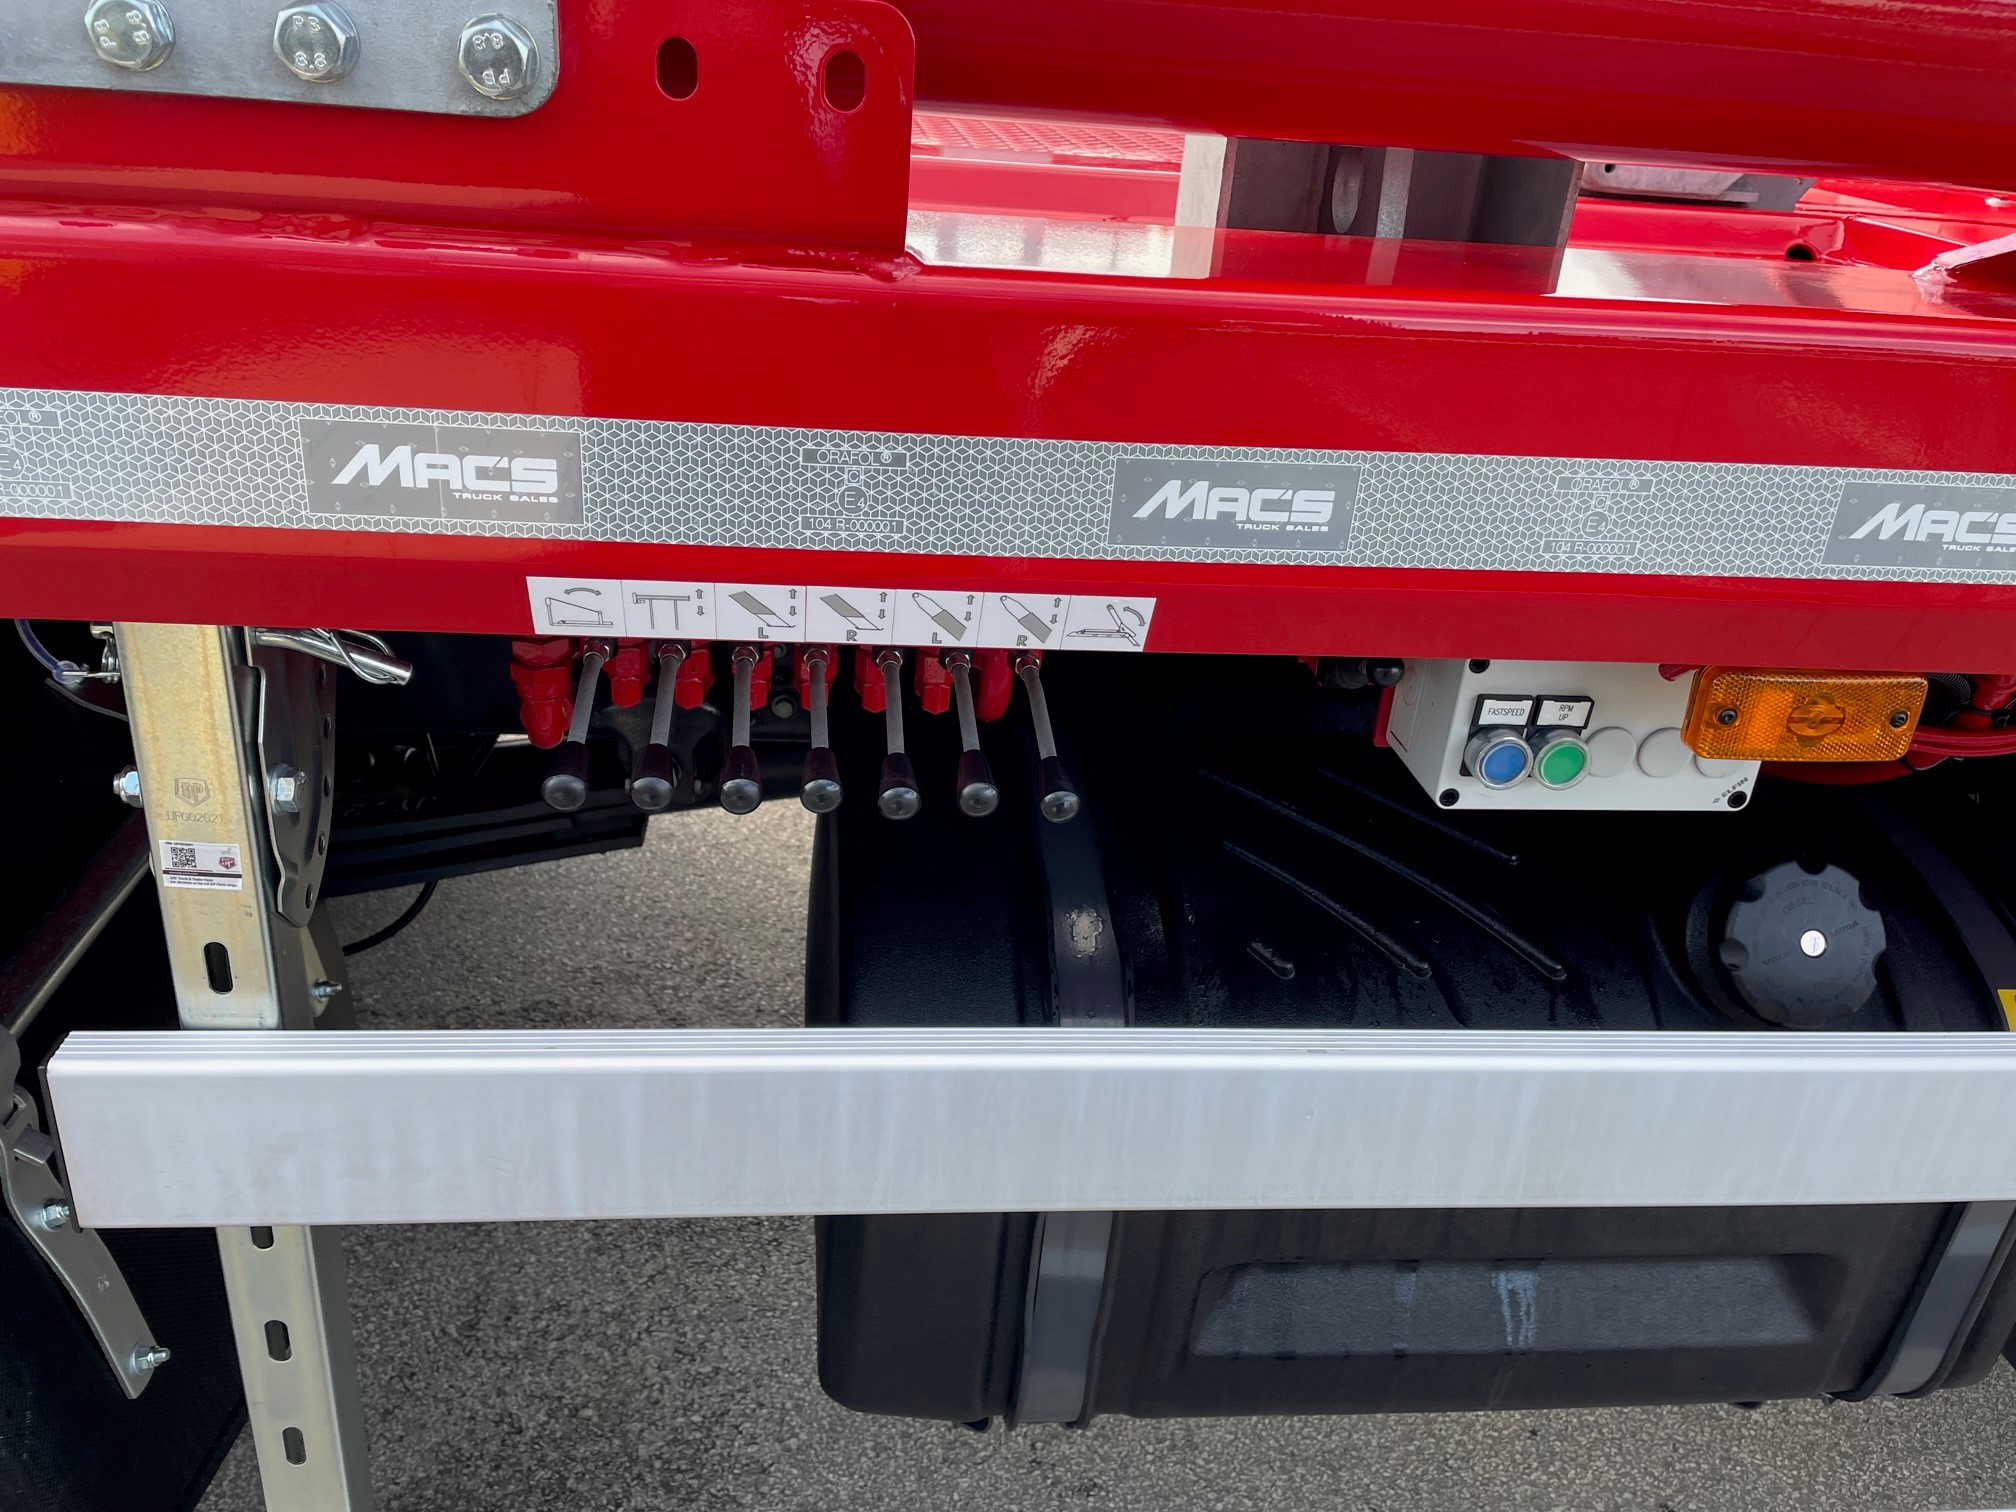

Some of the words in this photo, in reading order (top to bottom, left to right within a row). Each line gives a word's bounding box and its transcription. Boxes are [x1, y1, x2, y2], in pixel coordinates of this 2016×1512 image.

[452, 492, 503, 501] TRUCK
[509, 494, 559, 503] SALES
[809, 518, 832, 530] 104
[836, 519, 897, 532] R-000001
[1236, 523, 1281, 531] TRUCK
[1285, 524, 1329, 532] SALES
[1551, 542, 1571, 553] 104
[1941, 544, 1982, 552] TRUCK
[757, 626, 769, 639] L
[846, 629, 858, 642] R
[931, 632, 943, 644] L
[1016, 635, 1028, 647] R
[1487, 707, 1525, 716] FASTSPEED
[1559, 704, 1574, 712] RPM
[1559, 713, 1569, 721] UP
[1721, 776, 1748, 798] ELFIN
